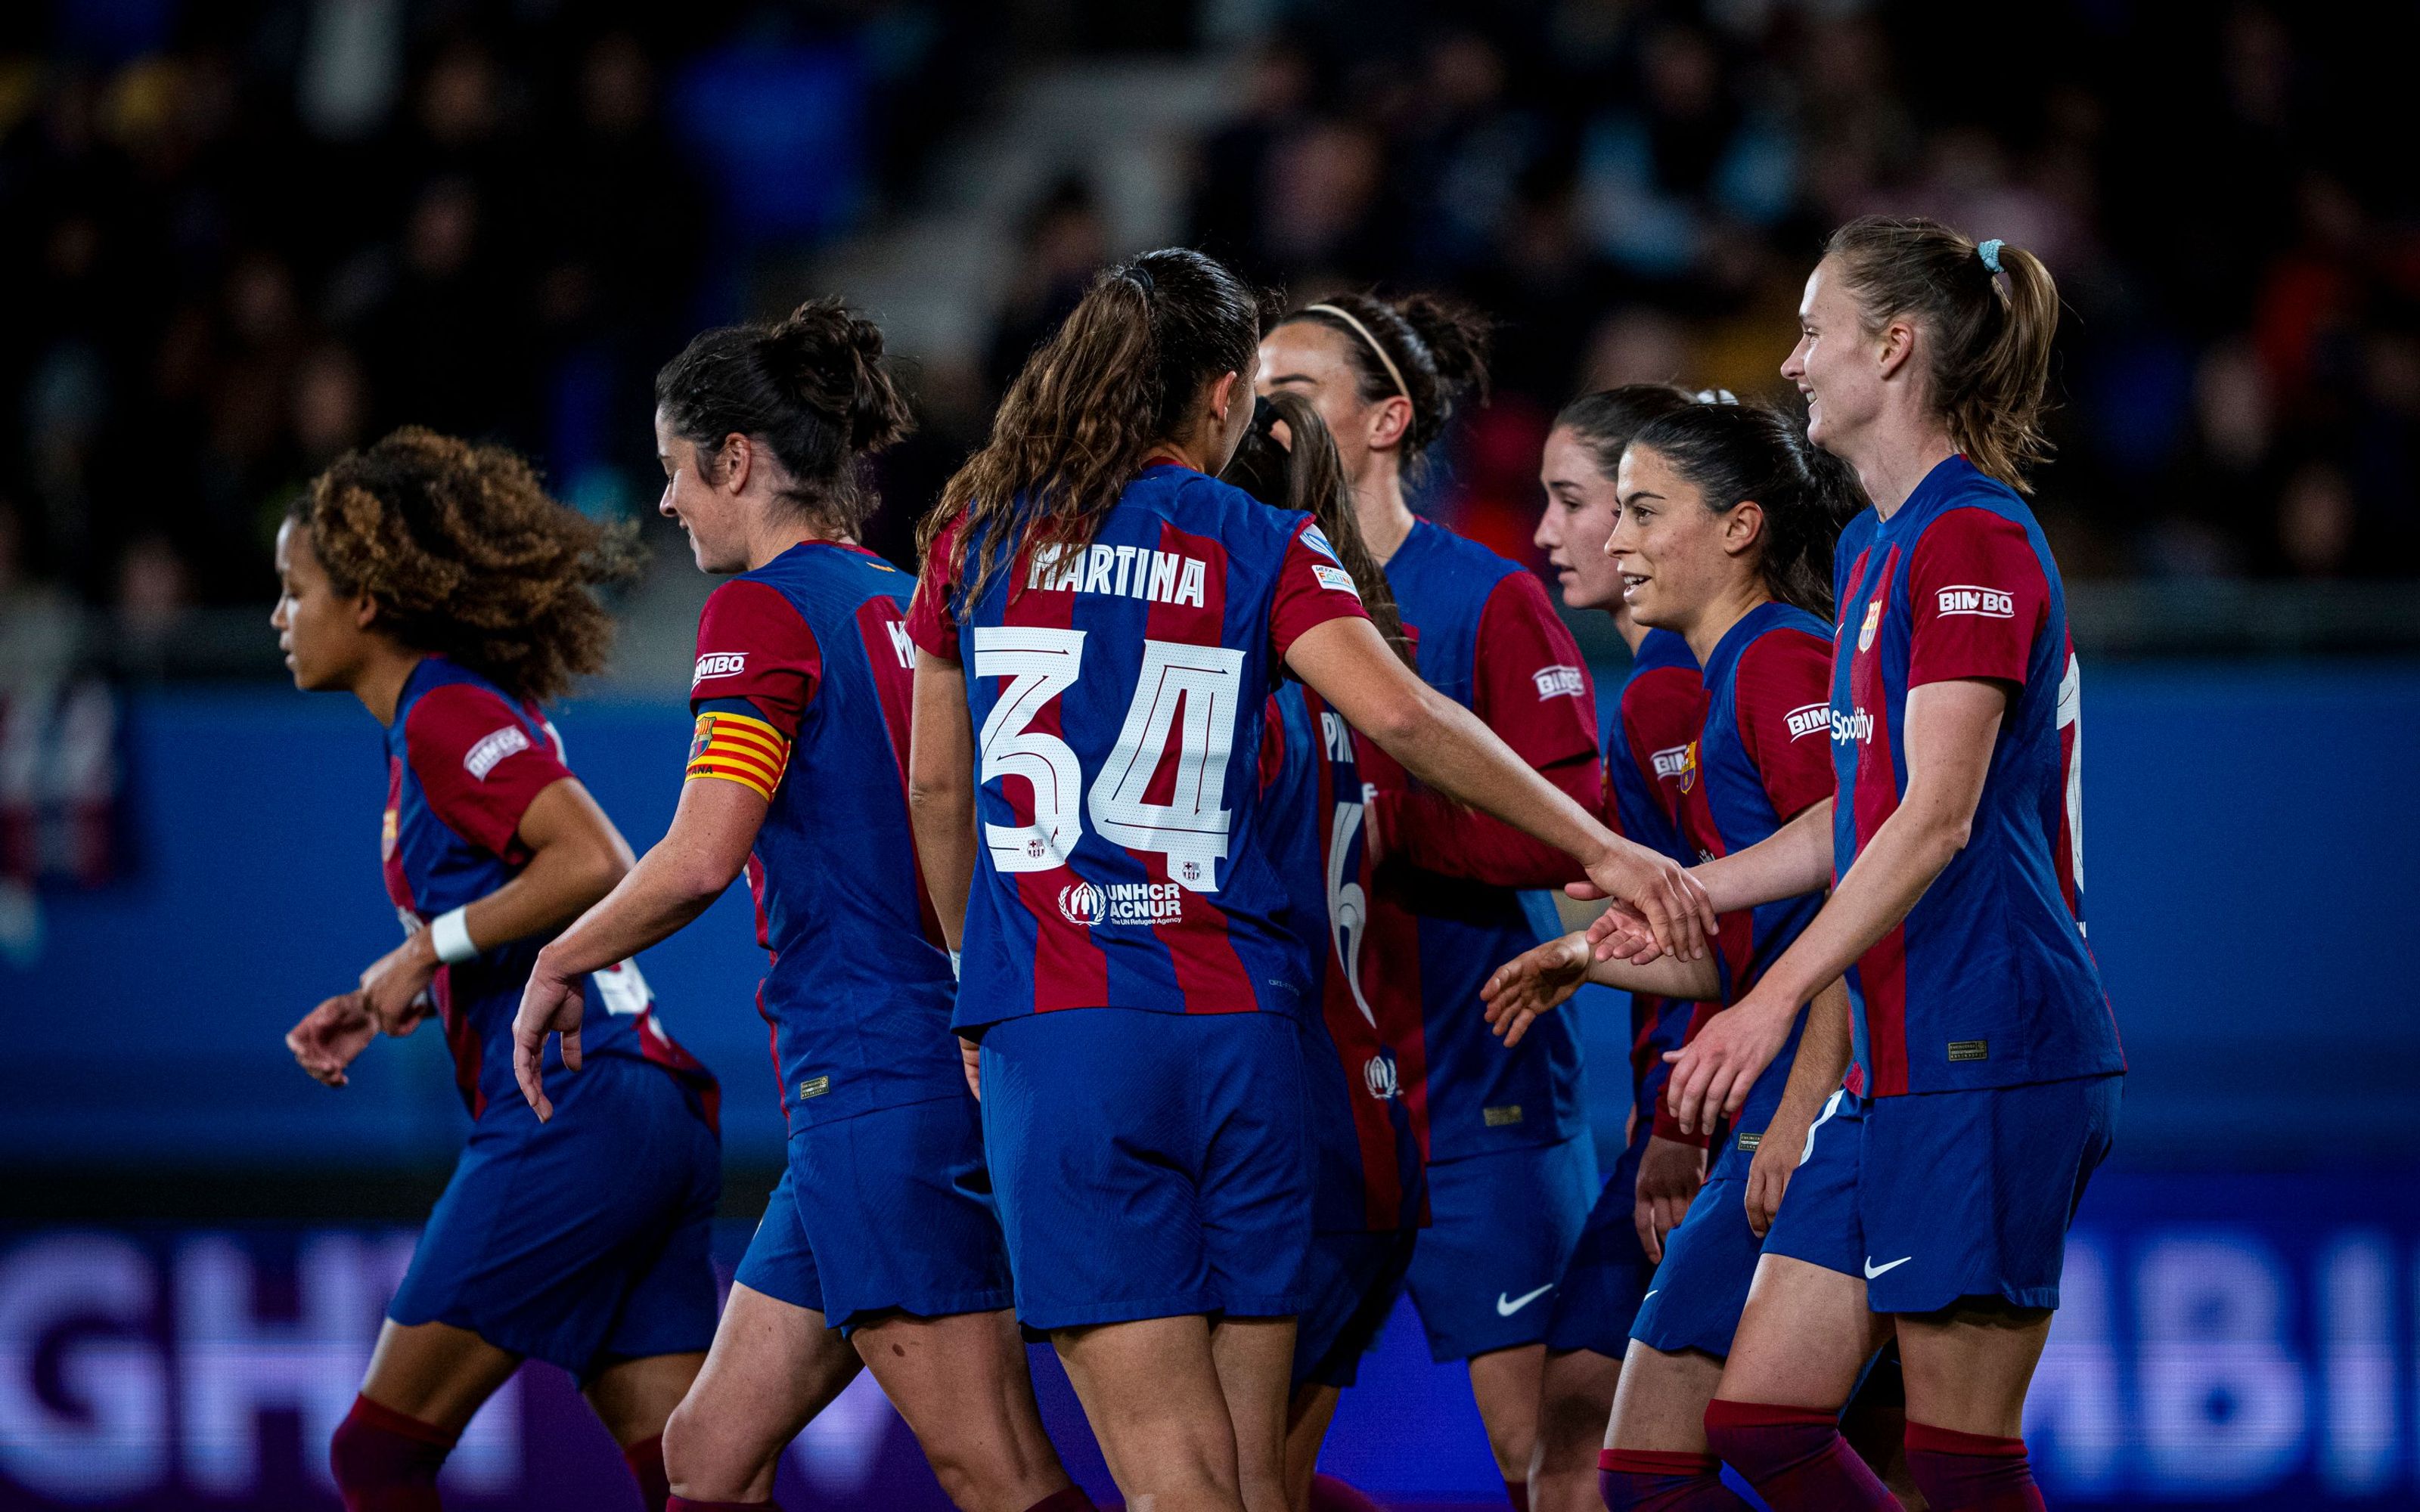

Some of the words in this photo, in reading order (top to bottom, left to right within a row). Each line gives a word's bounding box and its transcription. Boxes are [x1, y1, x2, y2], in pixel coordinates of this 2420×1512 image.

[1027, 541, 1206, 608] MARTINA
[692, 655, 745, 685] IMBO
[1831, 706, 1874, 746] Spotify
[974, 627, 1247, 892] 34
[1106, 883, 1181, 901] UNHCR
[1109, 900, 1182, 918] ACNUR
[1131, 918, 1156, 926] Refugee
[1156, 917, 1181, 925] Agency
